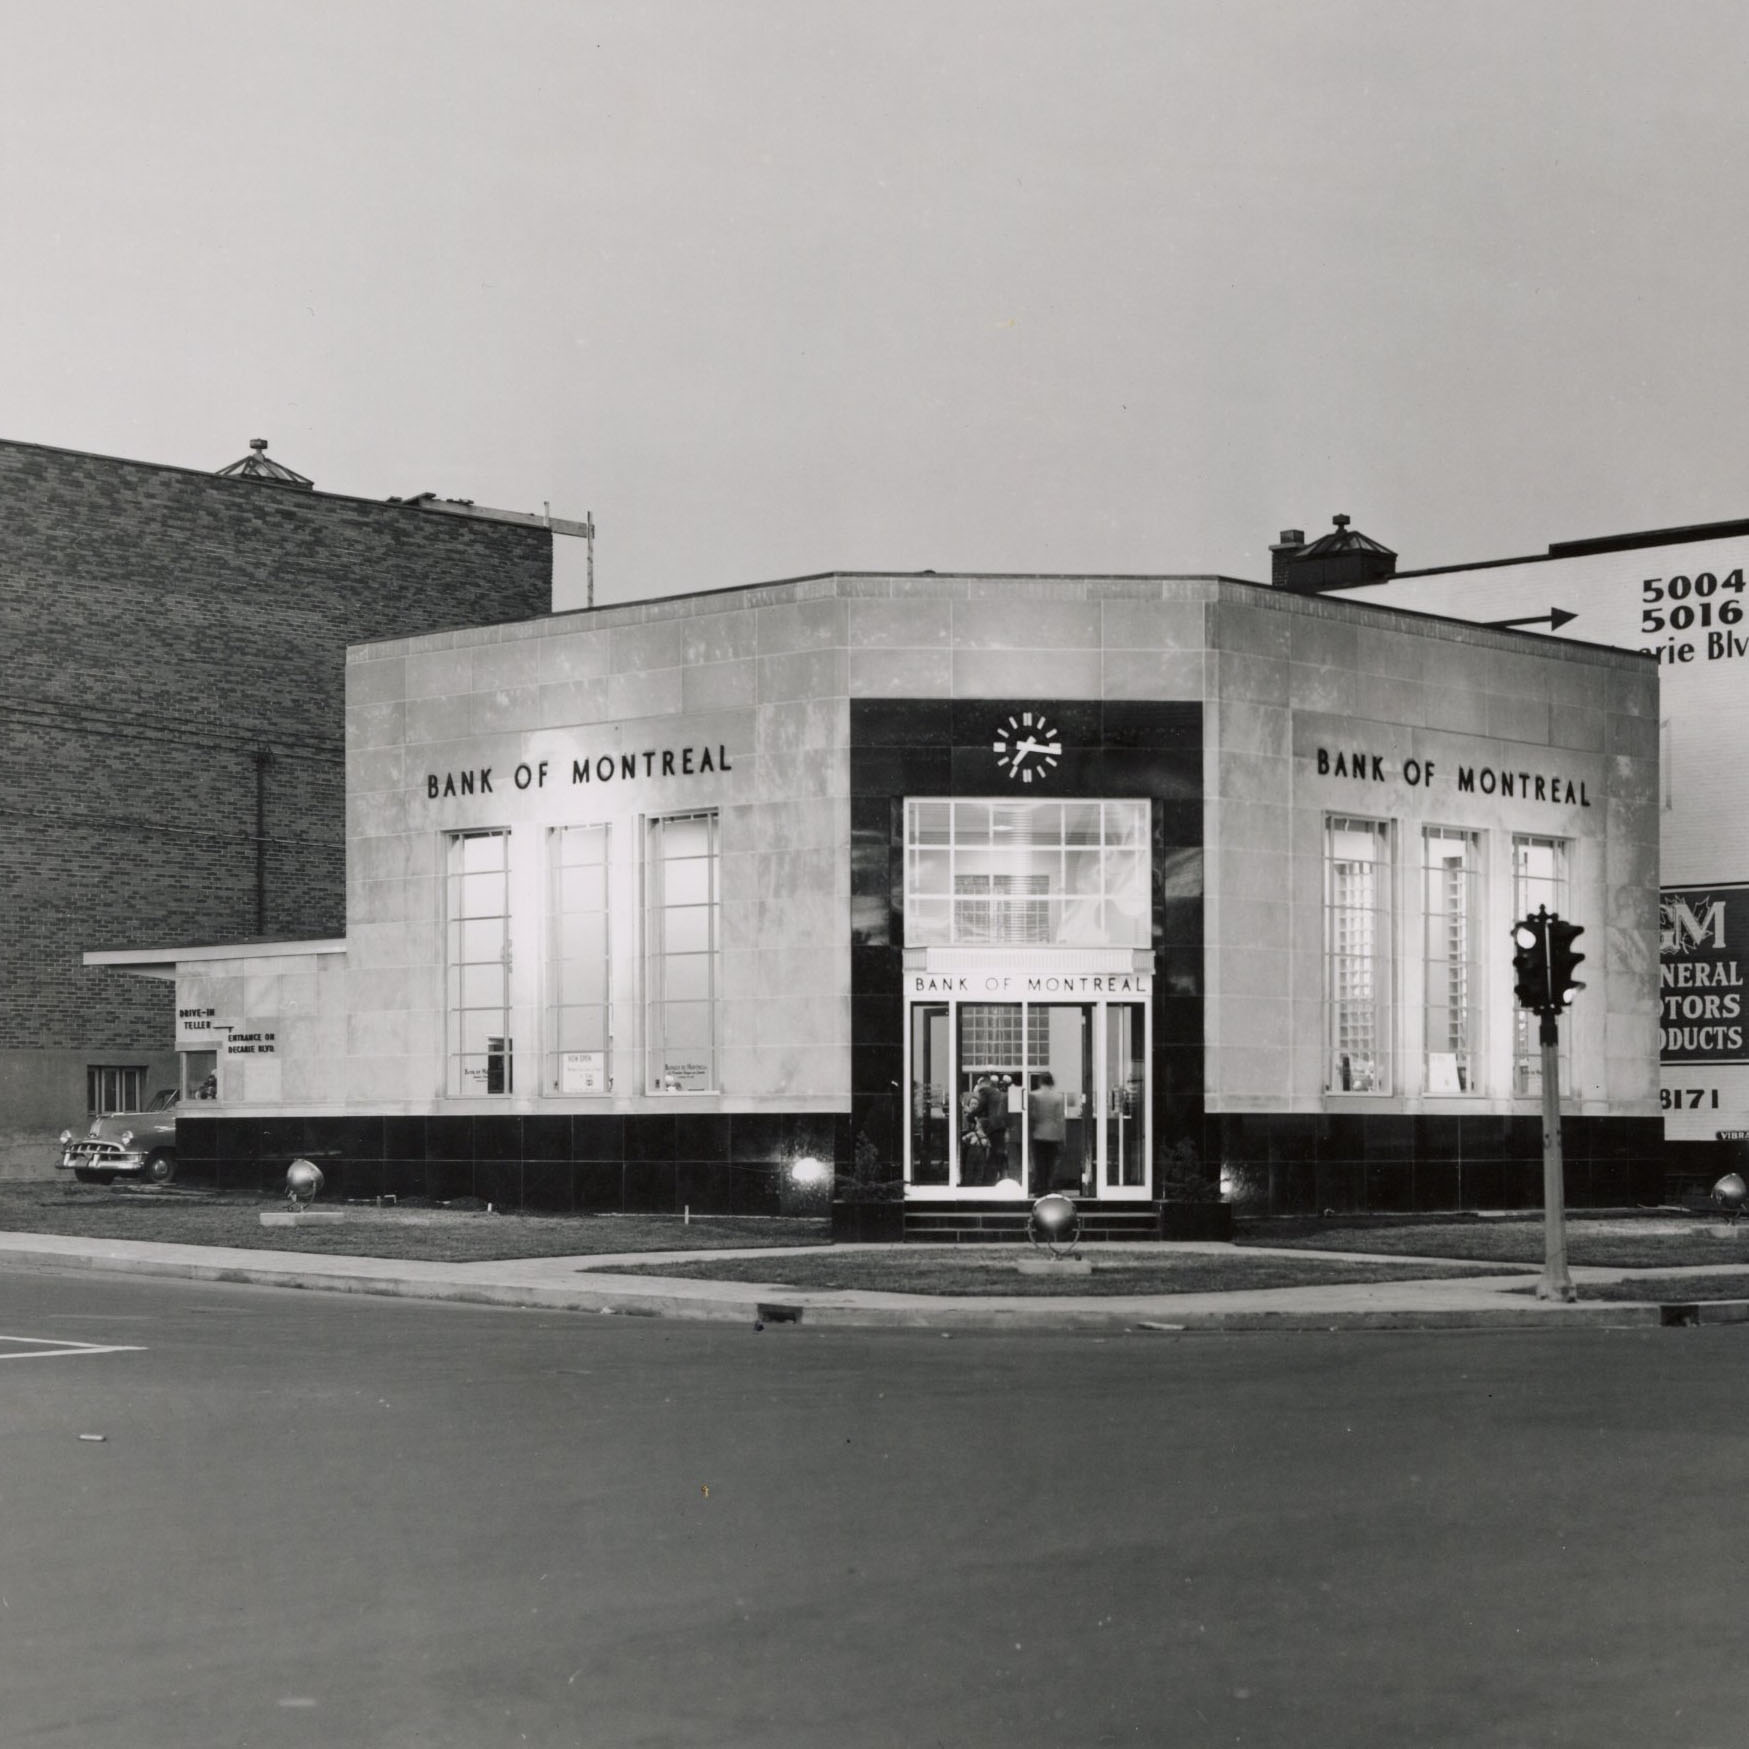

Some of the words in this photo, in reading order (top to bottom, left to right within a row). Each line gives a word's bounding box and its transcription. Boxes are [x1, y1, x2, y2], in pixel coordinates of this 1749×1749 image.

[1642, 569, 1746, 603] 5004
[1641, 600, 1744, 633] 5016
[428, 768, 493, 799] BANK
[514, 762, 549, 790] OF
[572, 745, 732, 785] MONTREAL
[1317, 748, 1385, 783] BANK
[1403, 758, 1435, 788] OF
[1458, 766, 1591, 808] MONTREAL
[916, 977, 968, 991] BANK
[985, 977, 1011, 991] OF
[1028, 977, 1147, 992] MONTREAL
[179, 1008, 215, 1018] DRIVE-IN
[184, 1021, 211, 1030] TELLER
[228, 1033, 262, 1042] ENTRANCE
[264, 1033, 275, 1041] ON
[228, 1045, 255, 1053] DECARIE
